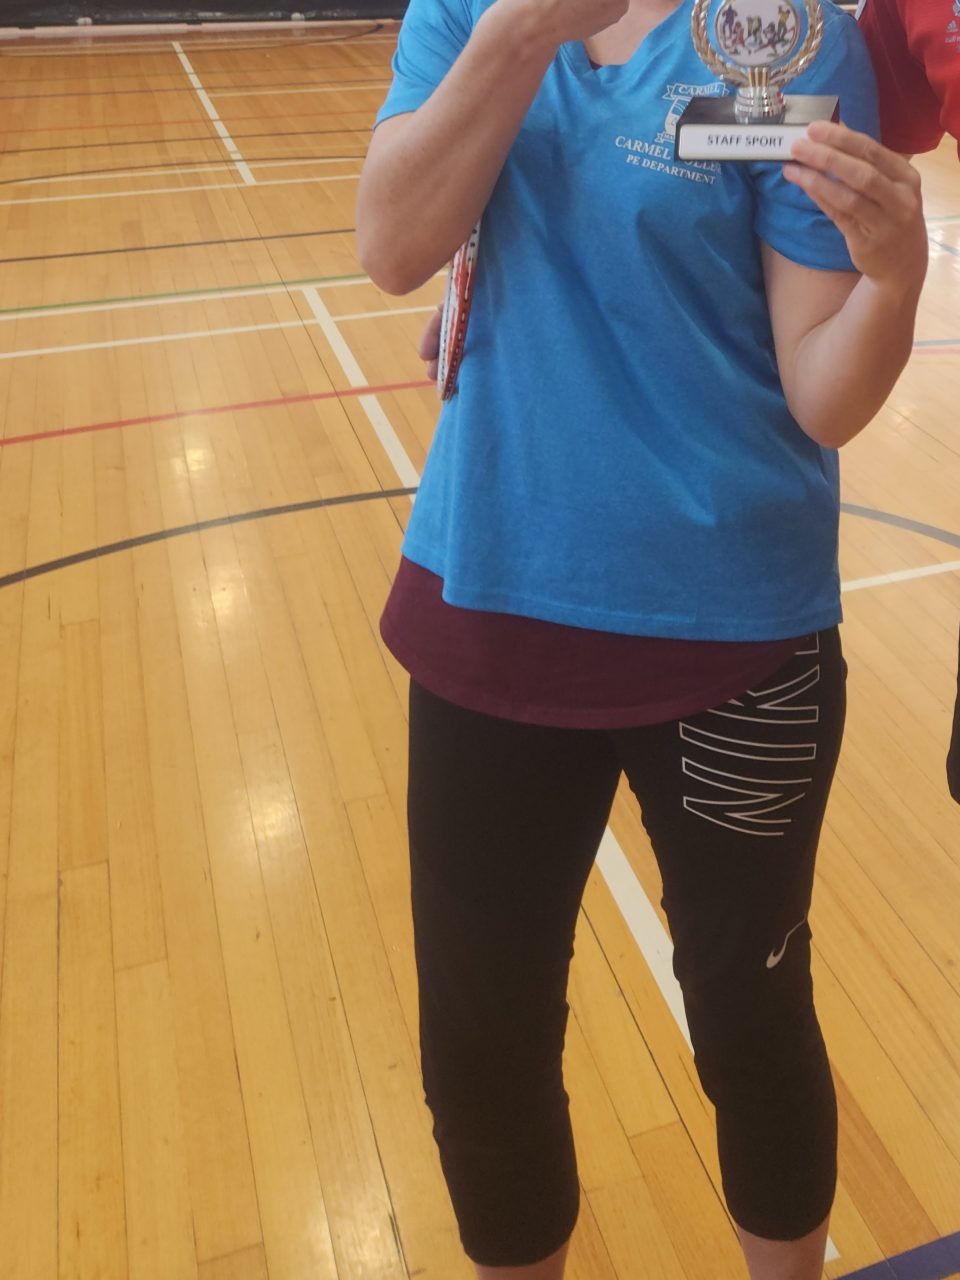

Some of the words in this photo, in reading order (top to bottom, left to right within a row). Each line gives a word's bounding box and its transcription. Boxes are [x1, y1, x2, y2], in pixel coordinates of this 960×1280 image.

[678, 84, 720, 95] CARMEL
[615, 136, 671, 160] CARMEL
[707, 135, 740, 146] STAFF
[745, 136, 784, 147] SPORT
[626, 154, 640, 166] PE
[642, 156, 717, 185] DEPARTMENT
[679, 632, 821, 836] NIK
